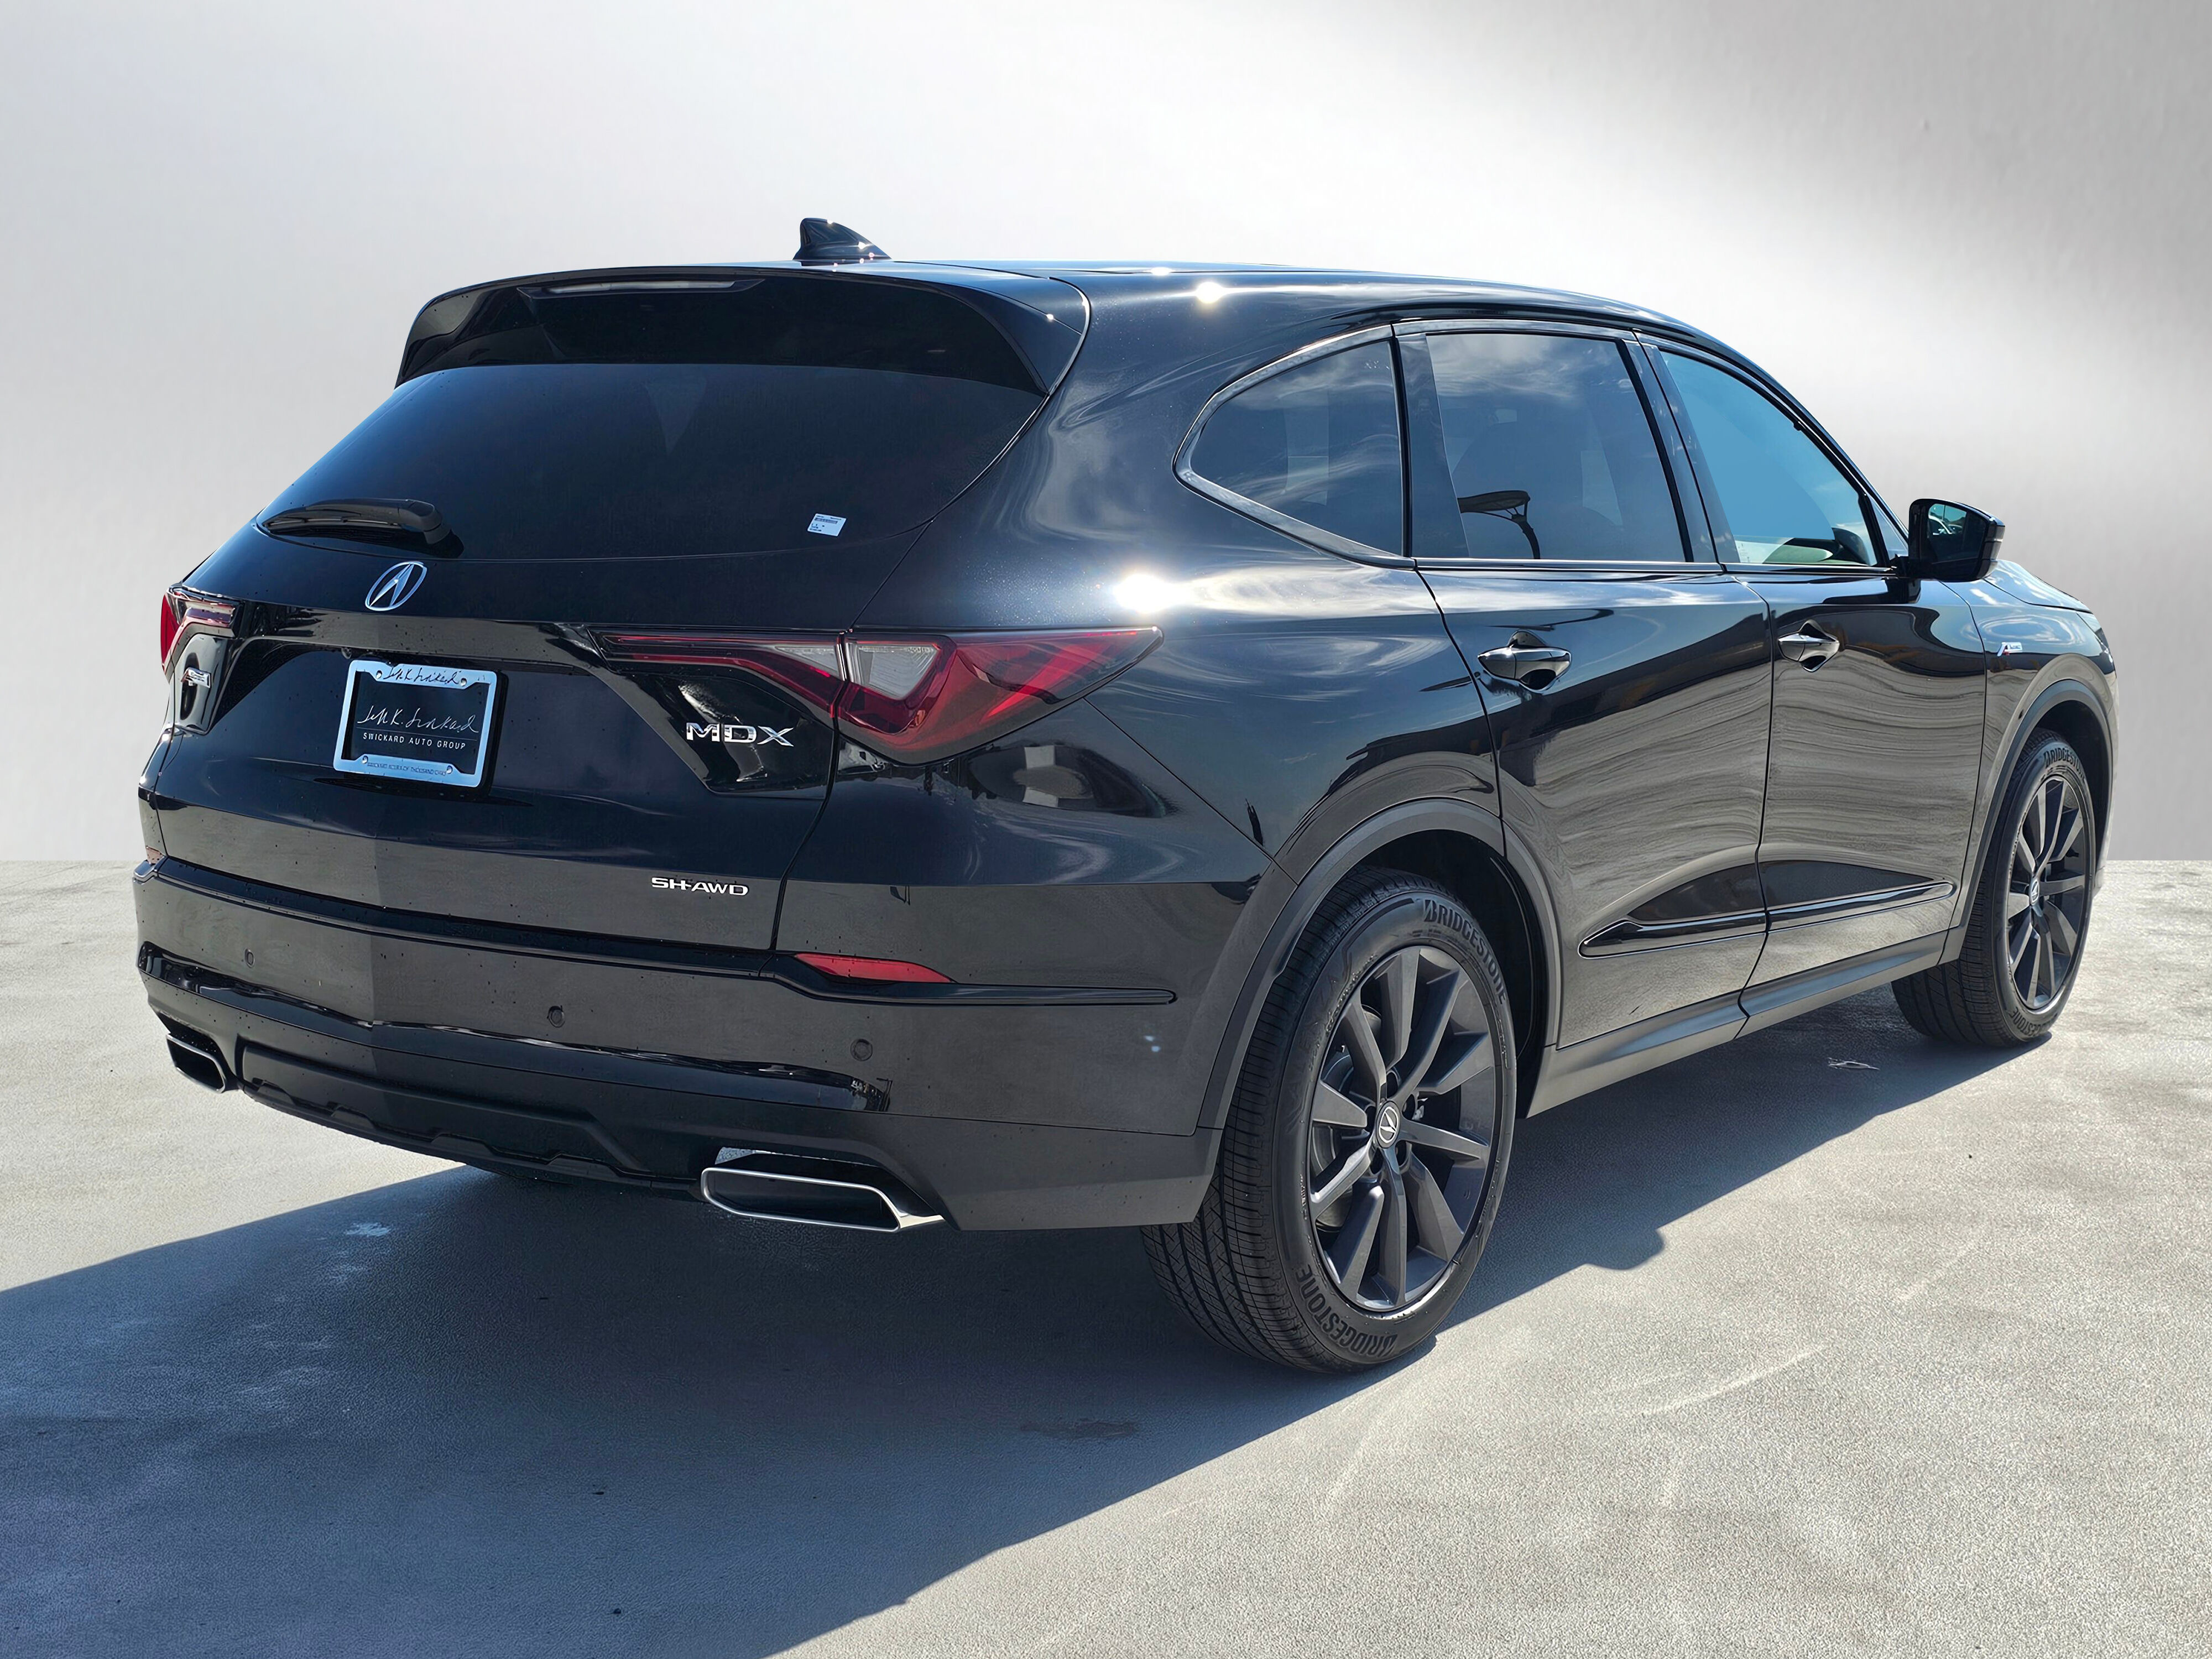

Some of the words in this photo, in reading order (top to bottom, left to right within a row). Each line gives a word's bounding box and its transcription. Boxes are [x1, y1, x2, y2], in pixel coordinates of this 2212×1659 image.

[363, 732, 405, 743] SWICKARD
[409, 737, 432, 747] AUTO
[437, 740, 466, 749] GROUP
[686, 722, 794, 747] MDX
[651, 877, 748, 896] SH-AWD
[1423, 899, 1506, 1004] BRIDGESTONE
[1295, 1264, 1398, 1358] BRIDGESTONE
